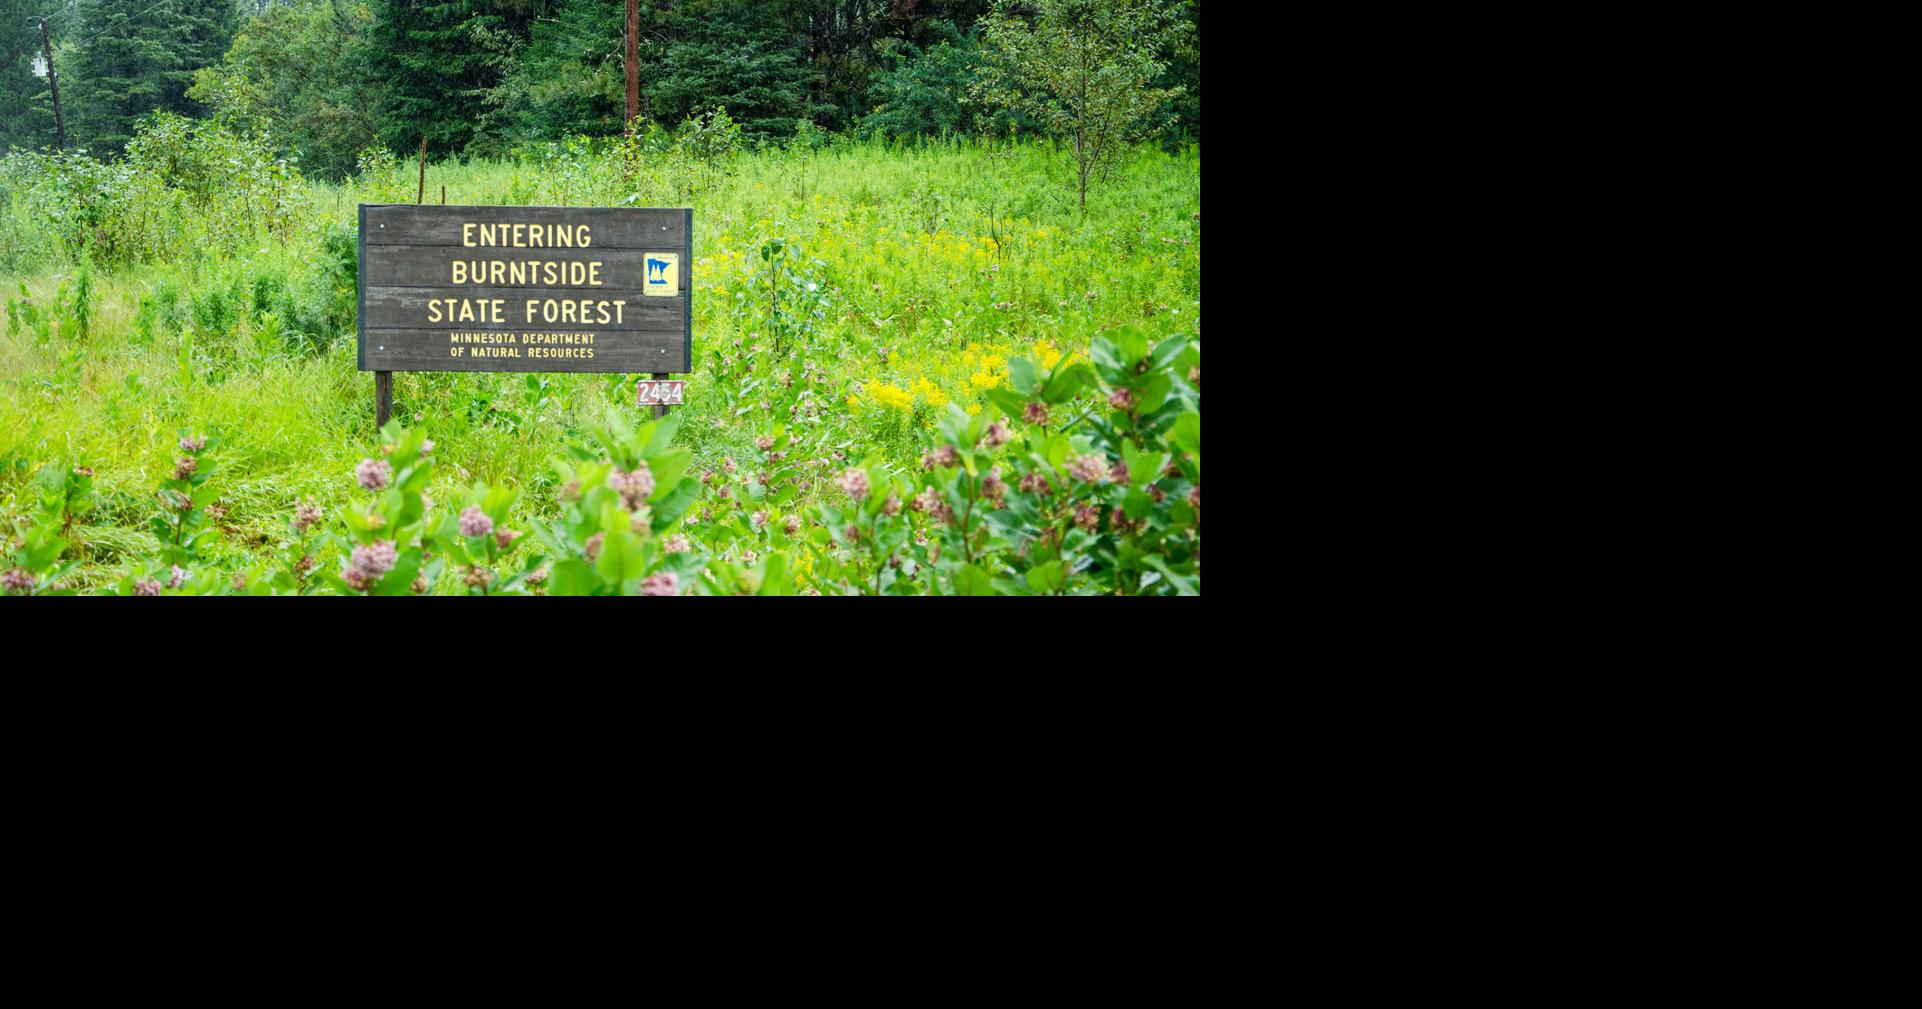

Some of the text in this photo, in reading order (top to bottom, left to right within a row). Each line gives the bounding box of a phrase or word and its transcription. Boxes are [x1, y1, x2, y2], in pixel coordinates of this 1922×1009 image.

[463, 223, 592, 248] ENTERING
[452, 260, 603, 286] BURNTSIDE
[427, 298, 626, 325] STATE FOREST
[450, 332, 595, 345] MINNESOTA DEPARTMENT
[450, 346, 594, 359] OF NATURAL RESOURCES
[639, 382, 683, 402] 2454
